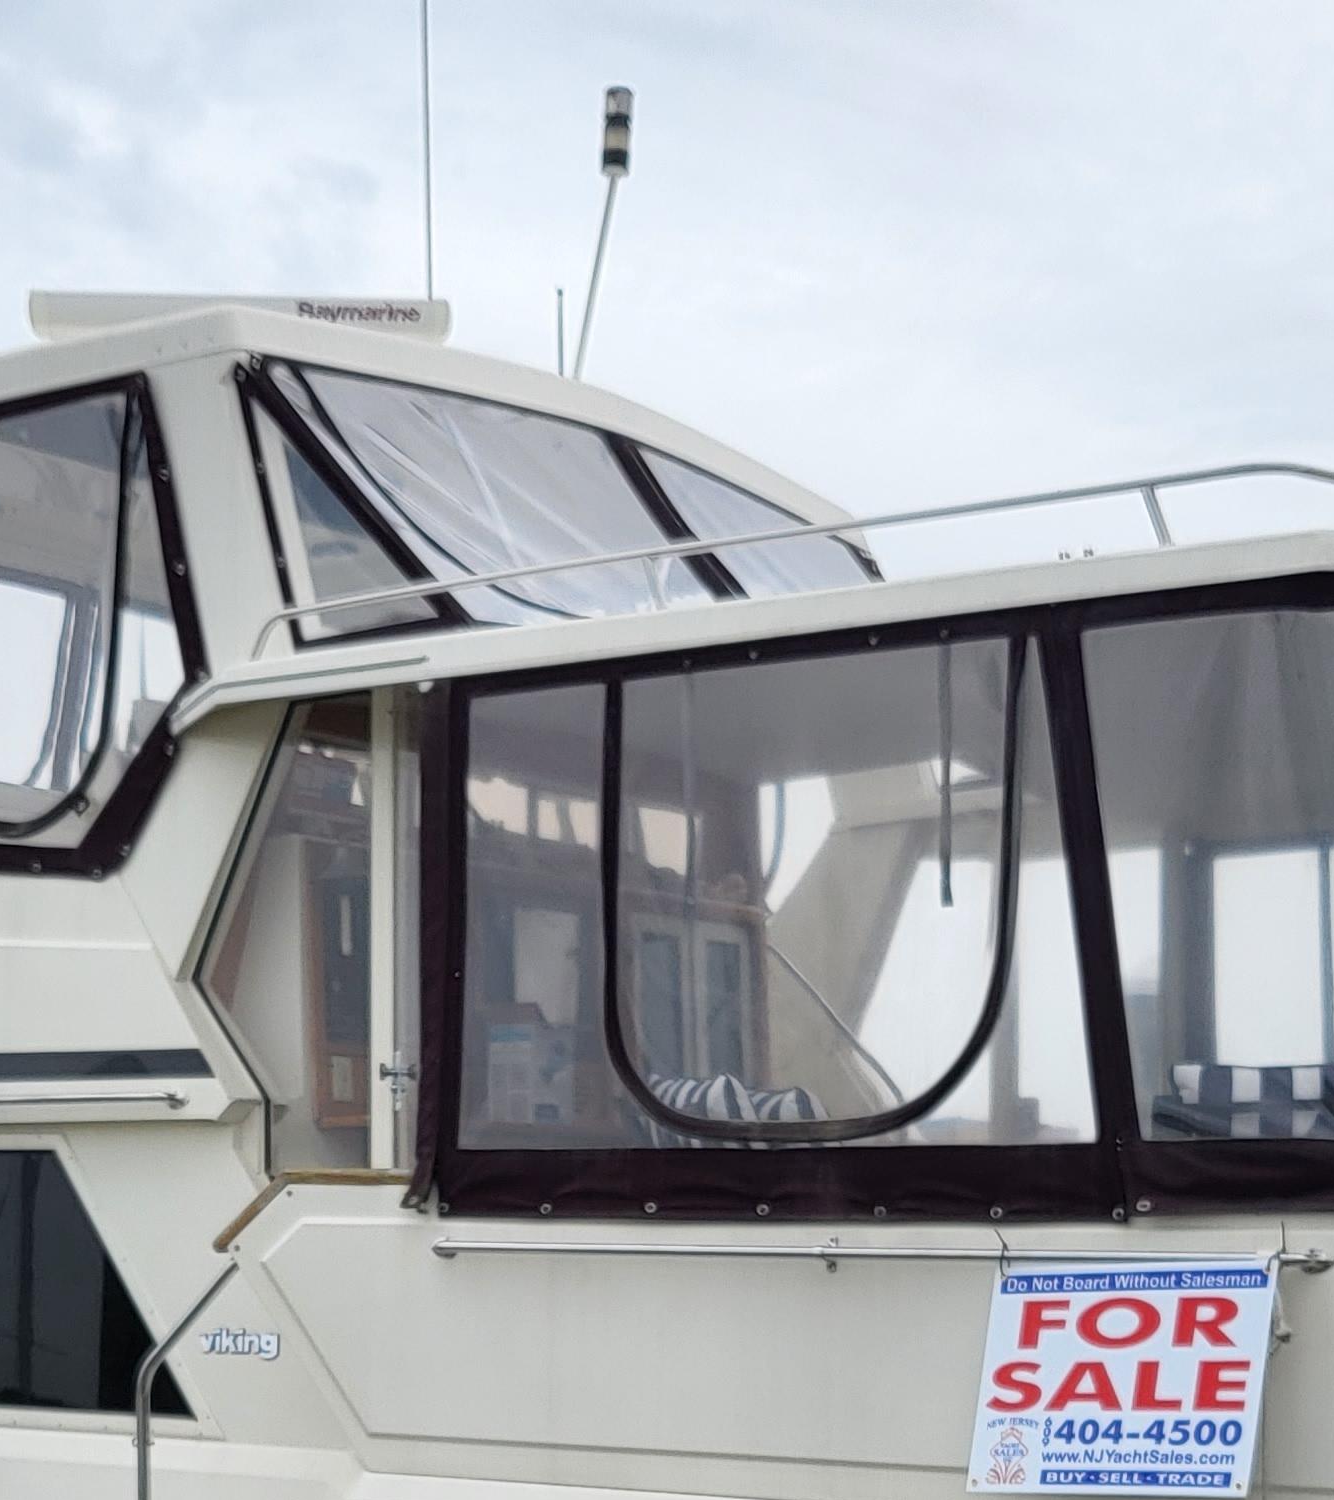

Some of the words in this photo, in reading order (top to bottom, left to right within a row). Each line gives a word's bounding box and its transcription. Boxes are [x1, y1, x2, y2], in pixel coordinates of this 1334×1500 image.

[297, 301, 421, 323] Raymarine
[1007, 1277, 1028, 1292] Do
[1032, 1276, 1059, 1291] Not
[1063, 1274, 1110, 1291] Board
[1115, 1273, 1176, 1289] Without
[1180, 1271, 1261, 1288] Salesman
[1017, 1296, 1239, 1350] FOR
[199, 1327, 281, 1361] viking
[985, 1359, 1251, 1412] SALE
[986, 1416, 1008, 1431] NEW
[1054, 1418, 1243, 1447] 404-4500
[1041, 1449, 1236, 1466] www.NJYachtSales.com
[1045, 1471, 1087, 1483] BUY
[1098, 1472, 1146, 1485] SELL
[1156, 1472, 1225, 1486] TRADE
